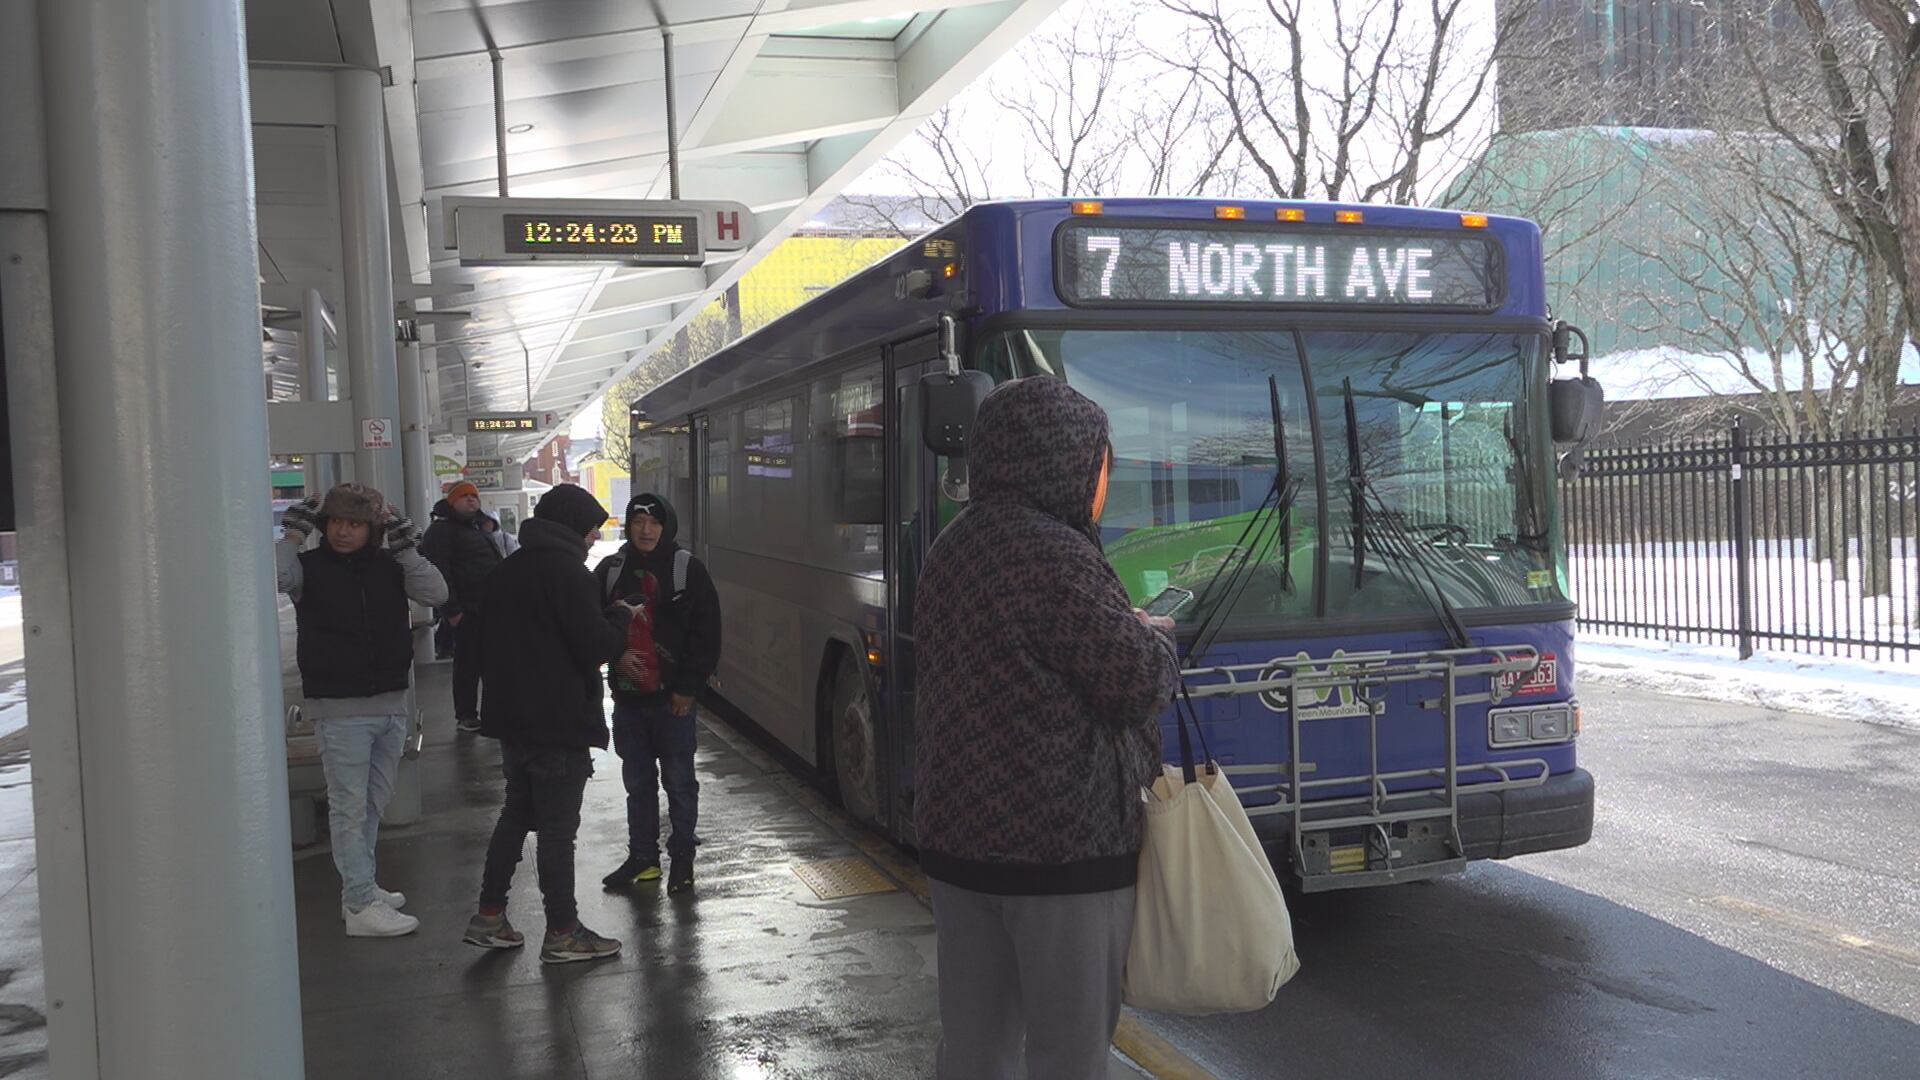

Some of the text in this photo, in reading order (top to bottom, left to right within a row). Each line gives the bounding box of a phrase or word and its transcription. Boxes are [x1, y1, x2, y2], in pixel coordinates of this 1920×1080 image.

[524, 222, 683, 243] 12:24:23 PM
[717, 211, 739, 240] H
[1087, 236, 1432, 298] 7 NORTH AVE
[475, 420, 516, 429] 12:24:23
[545, 414, 552, 424] F
[1320, 704, 1357, 717] Mountain
